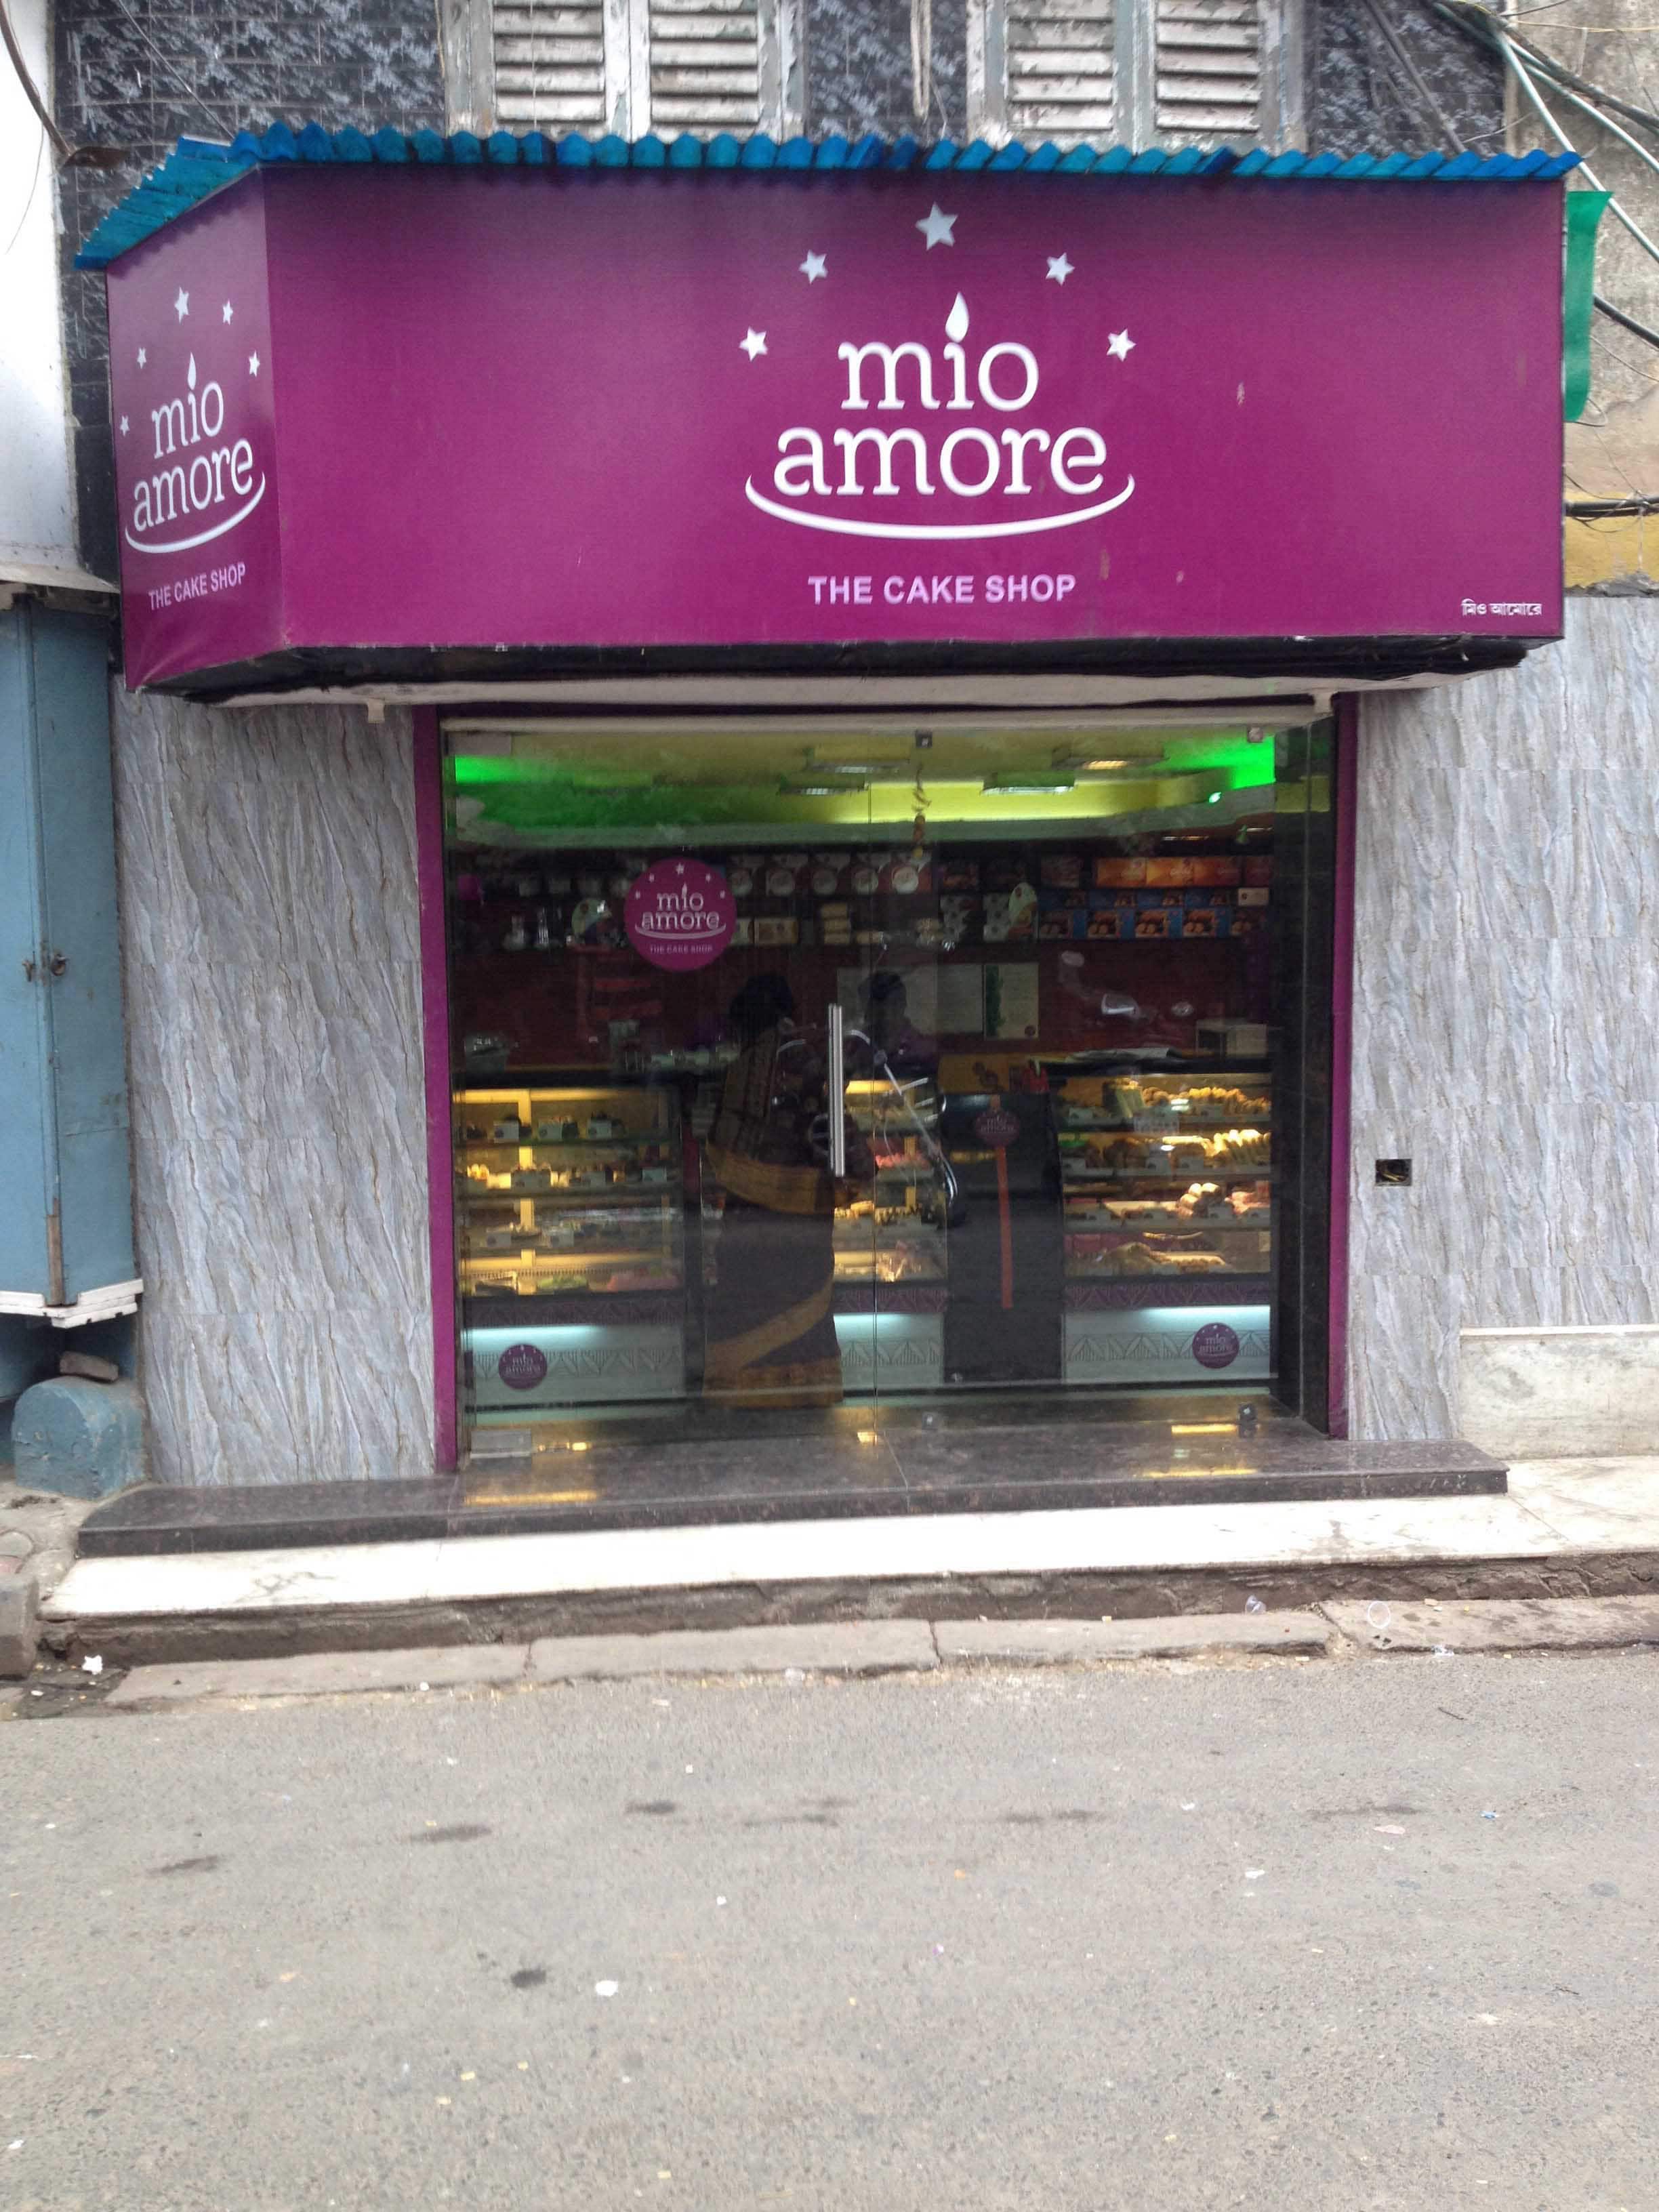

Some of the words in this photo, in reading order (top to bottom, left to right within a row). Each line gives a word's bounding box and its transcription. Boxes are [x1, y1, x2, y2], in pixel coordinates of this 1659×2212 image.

[838, 291, 1039, 411] mio
[152, 352, 224, 459] mio
[134, 438, 253, 531] amore
[773, 427, 1107, 497] amore
[148, 585, 171, 610] THE
[173, 574, 207, 603] CAKE
[210, 561, 245, 592] SHOP
[808, 576, 872, 605] THE
[884, 575, 974, 604] CAKE
[985, 574, 1076, 602] SHOP
[642, 912, 720, 930] amore
[657, 882, 703, 911] mio
